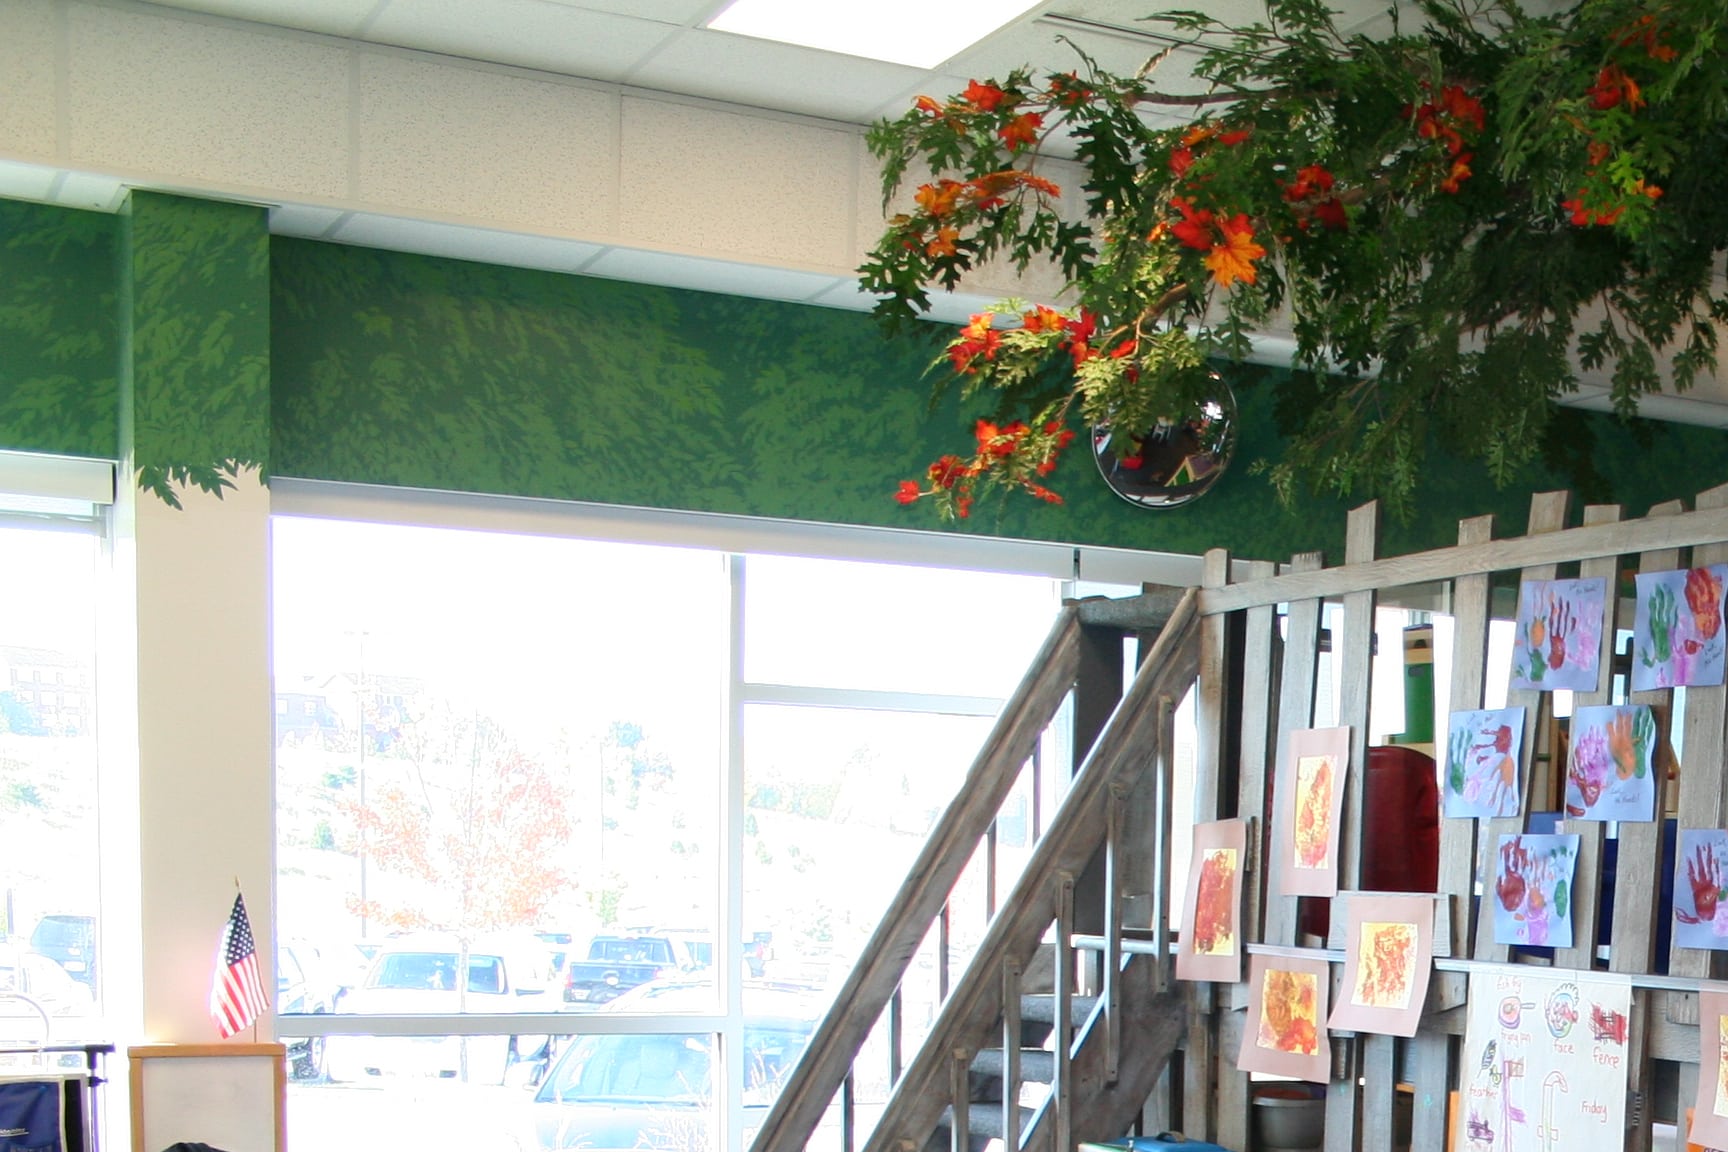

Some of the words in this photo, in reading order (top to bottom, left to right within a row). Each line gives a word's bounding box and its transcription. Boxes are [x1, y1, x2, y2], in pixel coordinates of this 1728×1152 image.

[1553, 1038, 1575, 1055] face
[1592, 1046, 1620, 1069] fence
[1581, 1099, 1608, 1123] Friday
